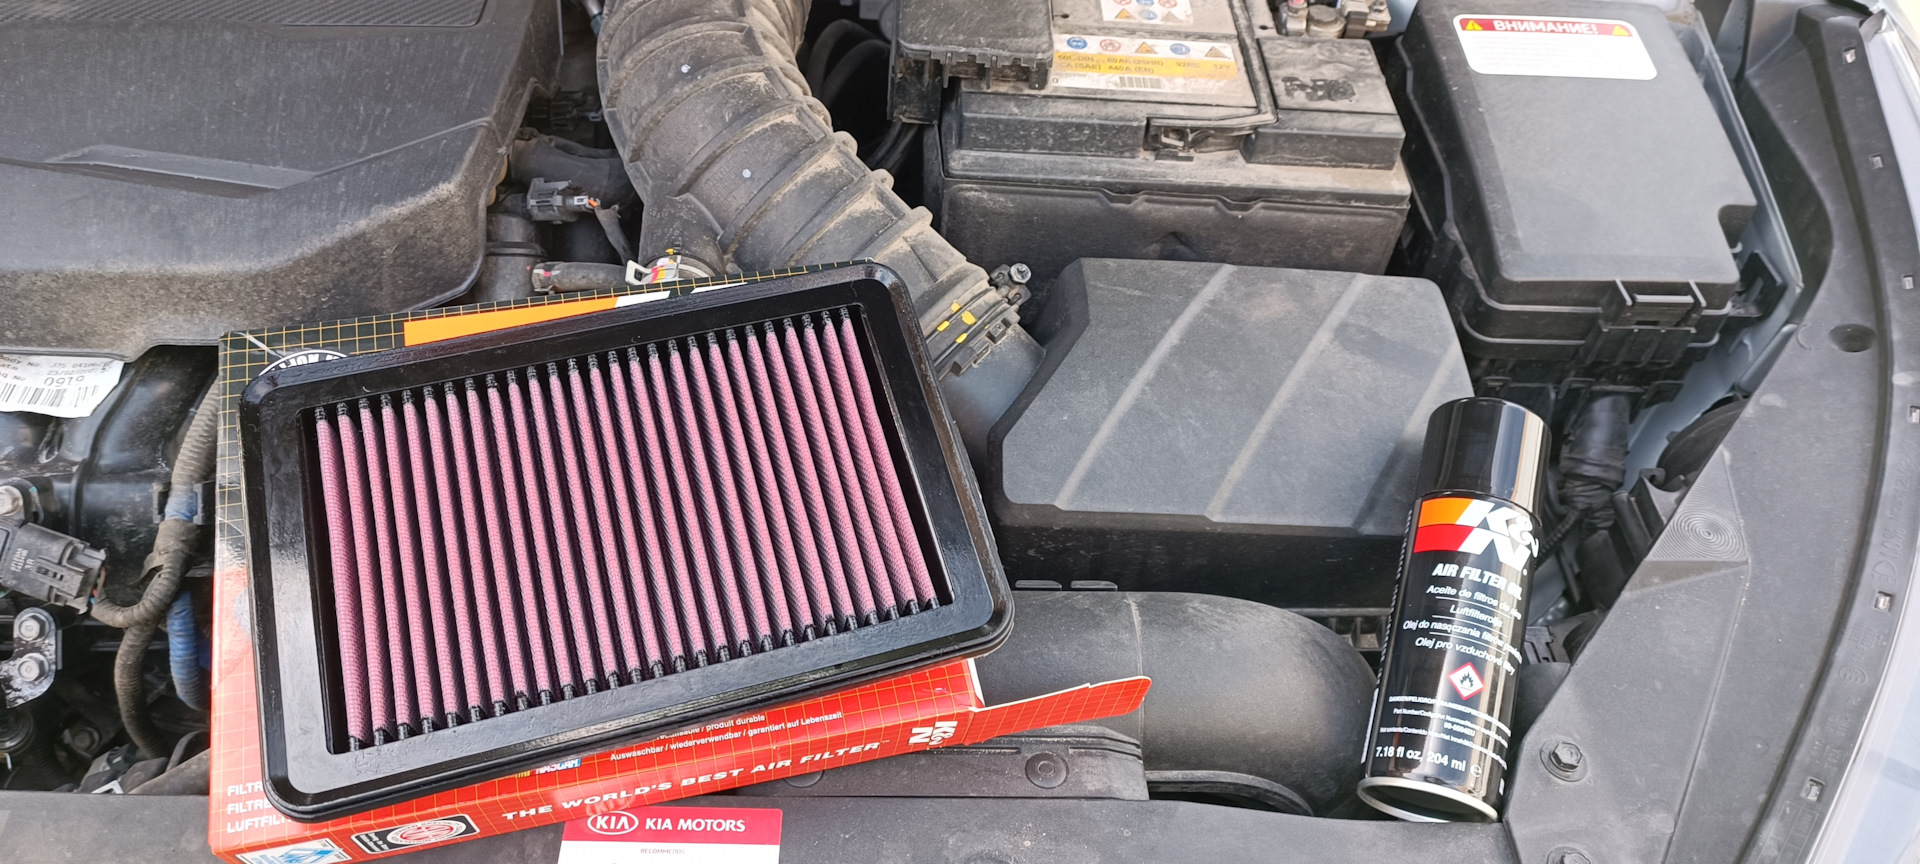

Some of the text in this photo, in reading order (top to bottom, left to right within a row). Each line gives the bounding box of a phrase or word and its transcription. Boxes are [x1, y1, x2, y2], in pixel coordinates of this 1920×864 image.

[1493, 20, 1598, 34] ВНИМАНИЕ!
[1454, 498, 1540, 573] K&N
[1432, 563, 1459, 577] AIR
[1460, 565, 1508, 591] FILTER
[1426, 585, 1457, 596] Aceite
[1459, 588, 1471, 599] de
[1474, 591, 1499, 607] filtros
[1403, 620, 1418, 631] Olej
[1418, 619, 1430, 629] do
[1415, 637, 1434, 649] Olej
[1435, 640, 1453, 650] pro
[706, 719, 735, 732] produit
[736, 714, 765, 725] durable
[908, 720, 958, 747] K&N
[610, 744, 664, 761] Auswaschbar
[670, 730, 742, 750] wiederverwendbar
[748, 723, 785, 737] garantiert
[787, 720, 799, 730] auf
[801, 712, 843, 726] Lebenszeit
[1375, 746, 1394, 757] 7.18
[1396, 747, 1404, 757] fl
[1406, 748, 1422, 762] oz,
[1426, 751, 1449, 766] 204
[1451, 759, 1467, 772] ml
[227, 781, 264, 797] FILTR
[502, 741, 881, 820] THE WORLD'S BEST AIR FILTER
[227, 813, 292, 834] LUFTFILT
[595, 815, 746, 832] KIA KIA MOTORS
